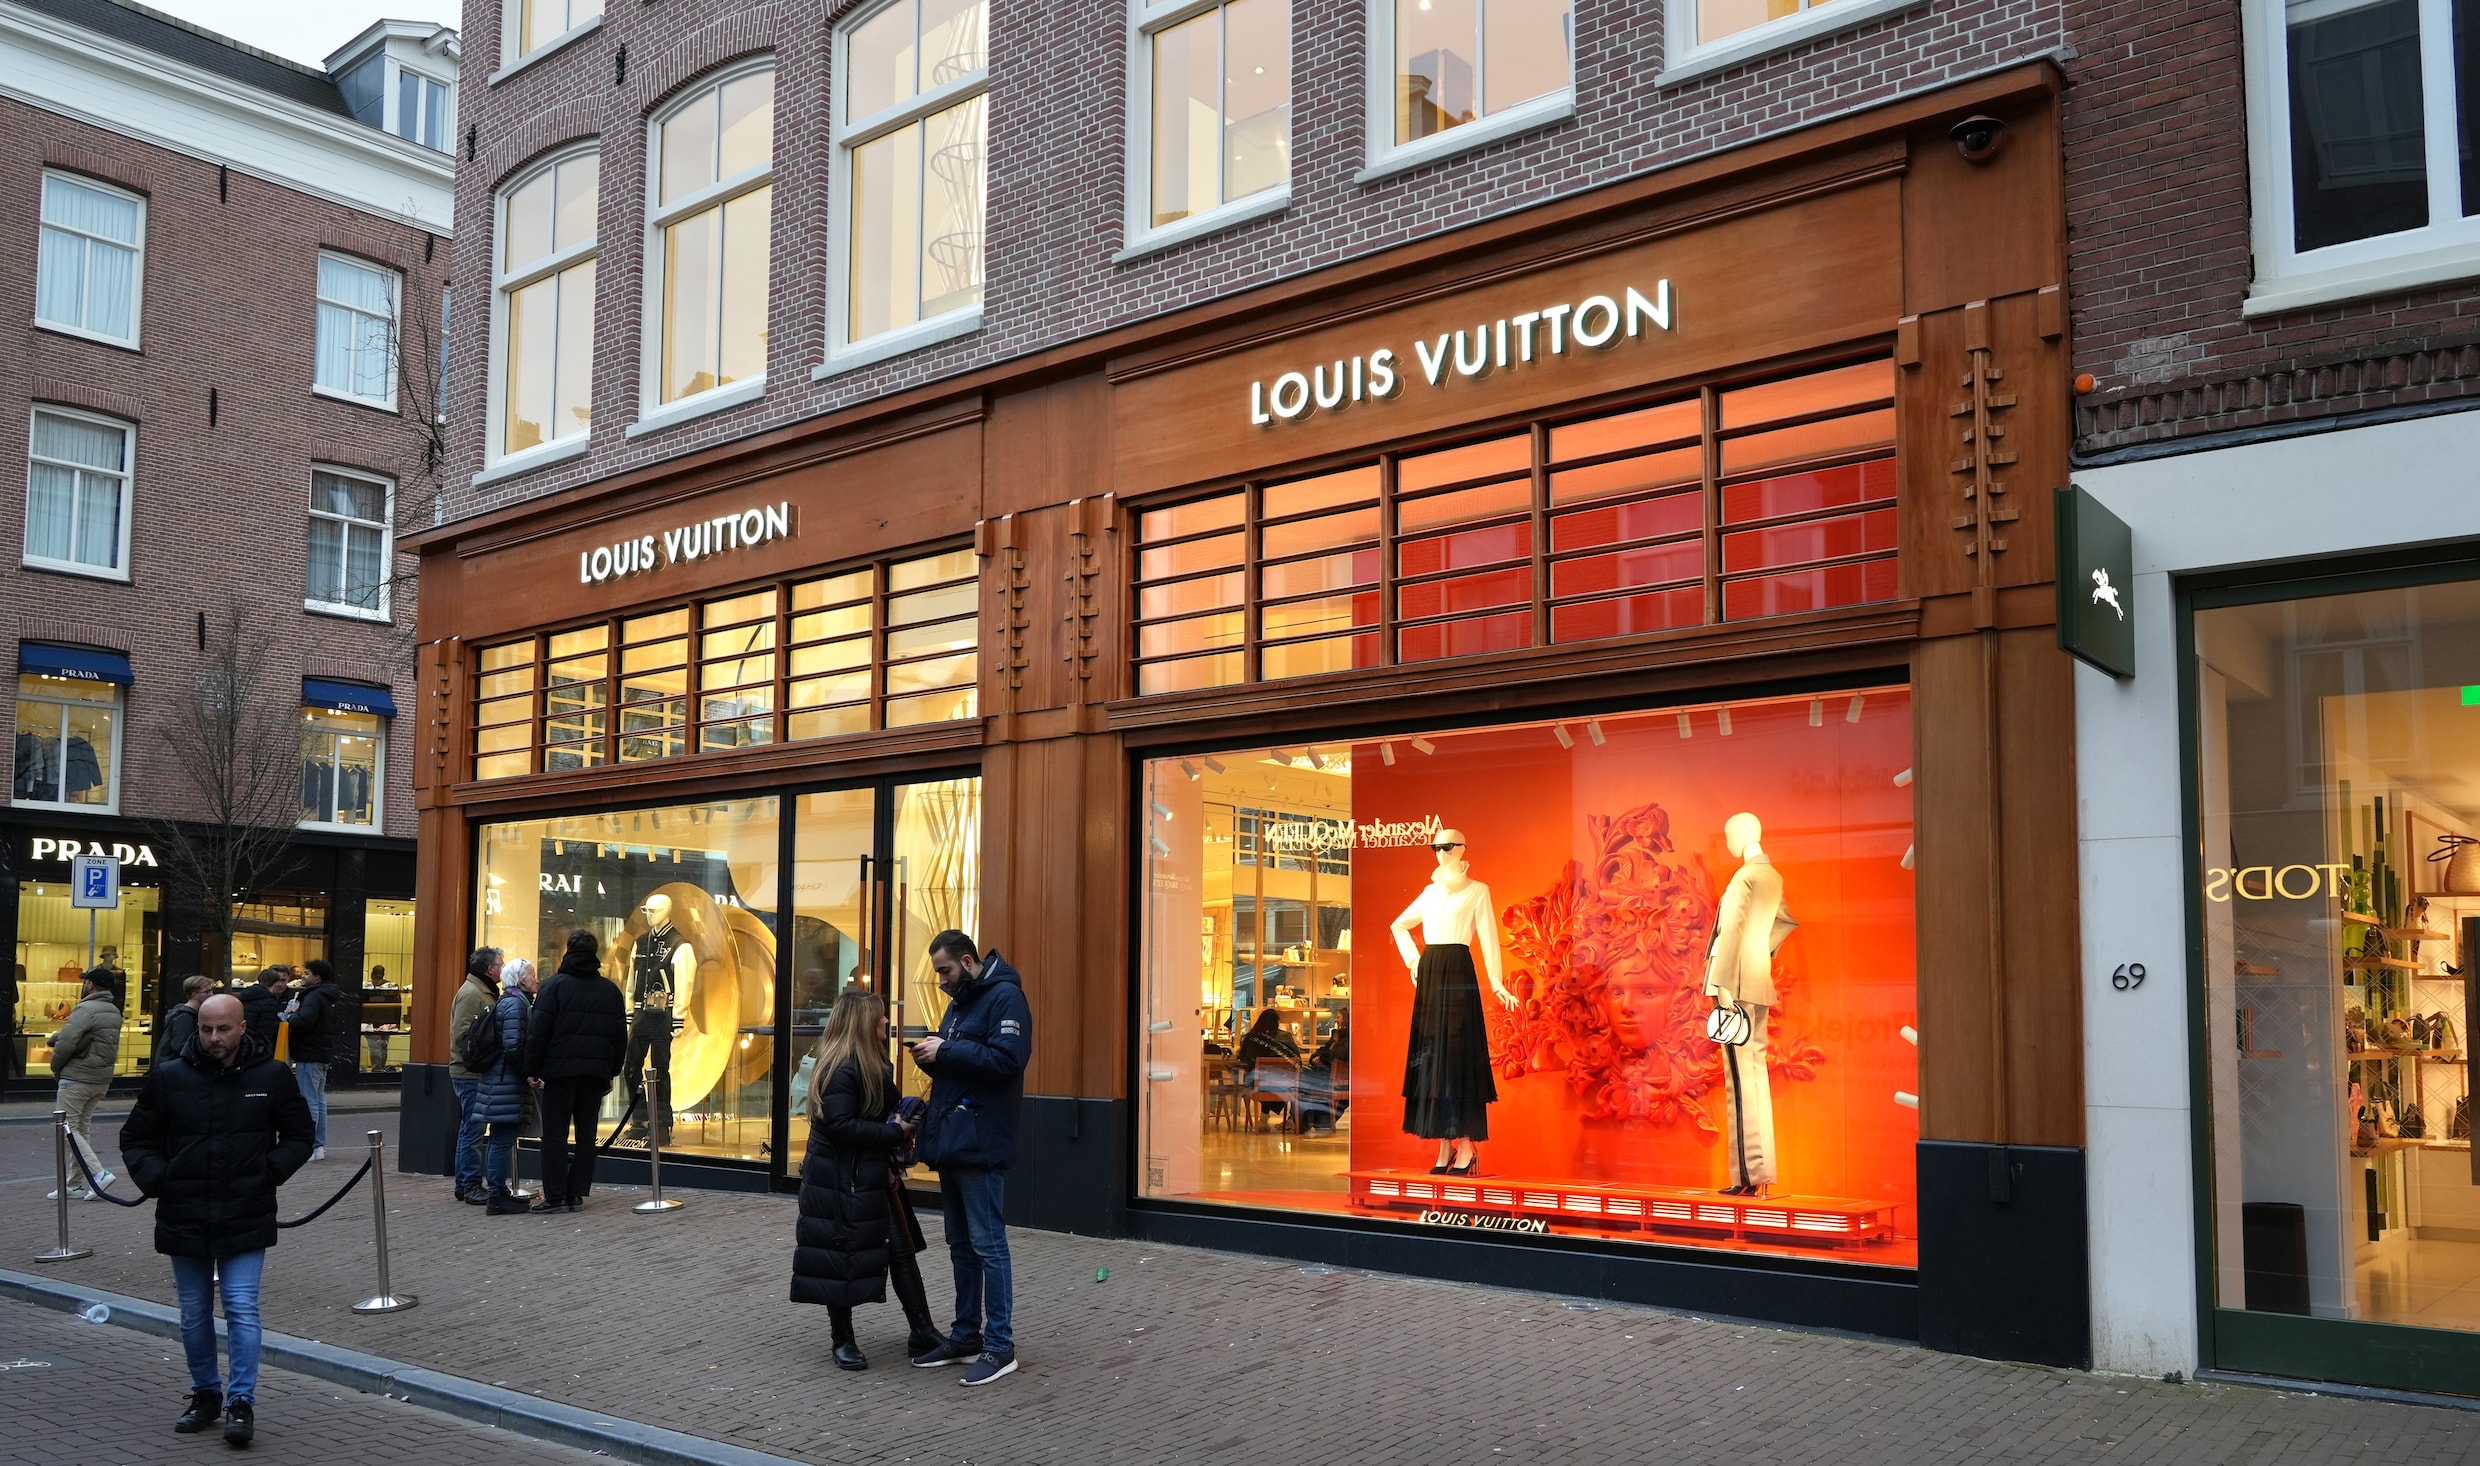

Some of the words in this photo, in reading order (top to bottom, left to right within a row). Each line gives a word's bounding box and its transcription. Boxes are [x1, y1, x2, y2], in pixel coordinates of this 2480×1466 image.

[1252, 349, 1395, 424] LOUIS
[1415, 279, 1671, 385] VUITTON
[581, 535, 656, 583] LOUIS
[664, 501, 791, 564] VUITTON
[61, 668, 99, 680] PRADA
[338, 702, 369, 713] PRADA
[31, 838, 158, 867] PRADA
[89, 869, 102, 885] P
[2113, 963, 2146, 990] 69
[1419, 1210, 1468, 1226] LOUIS
[1474, 1215, 1547, 1233] VUITTON
